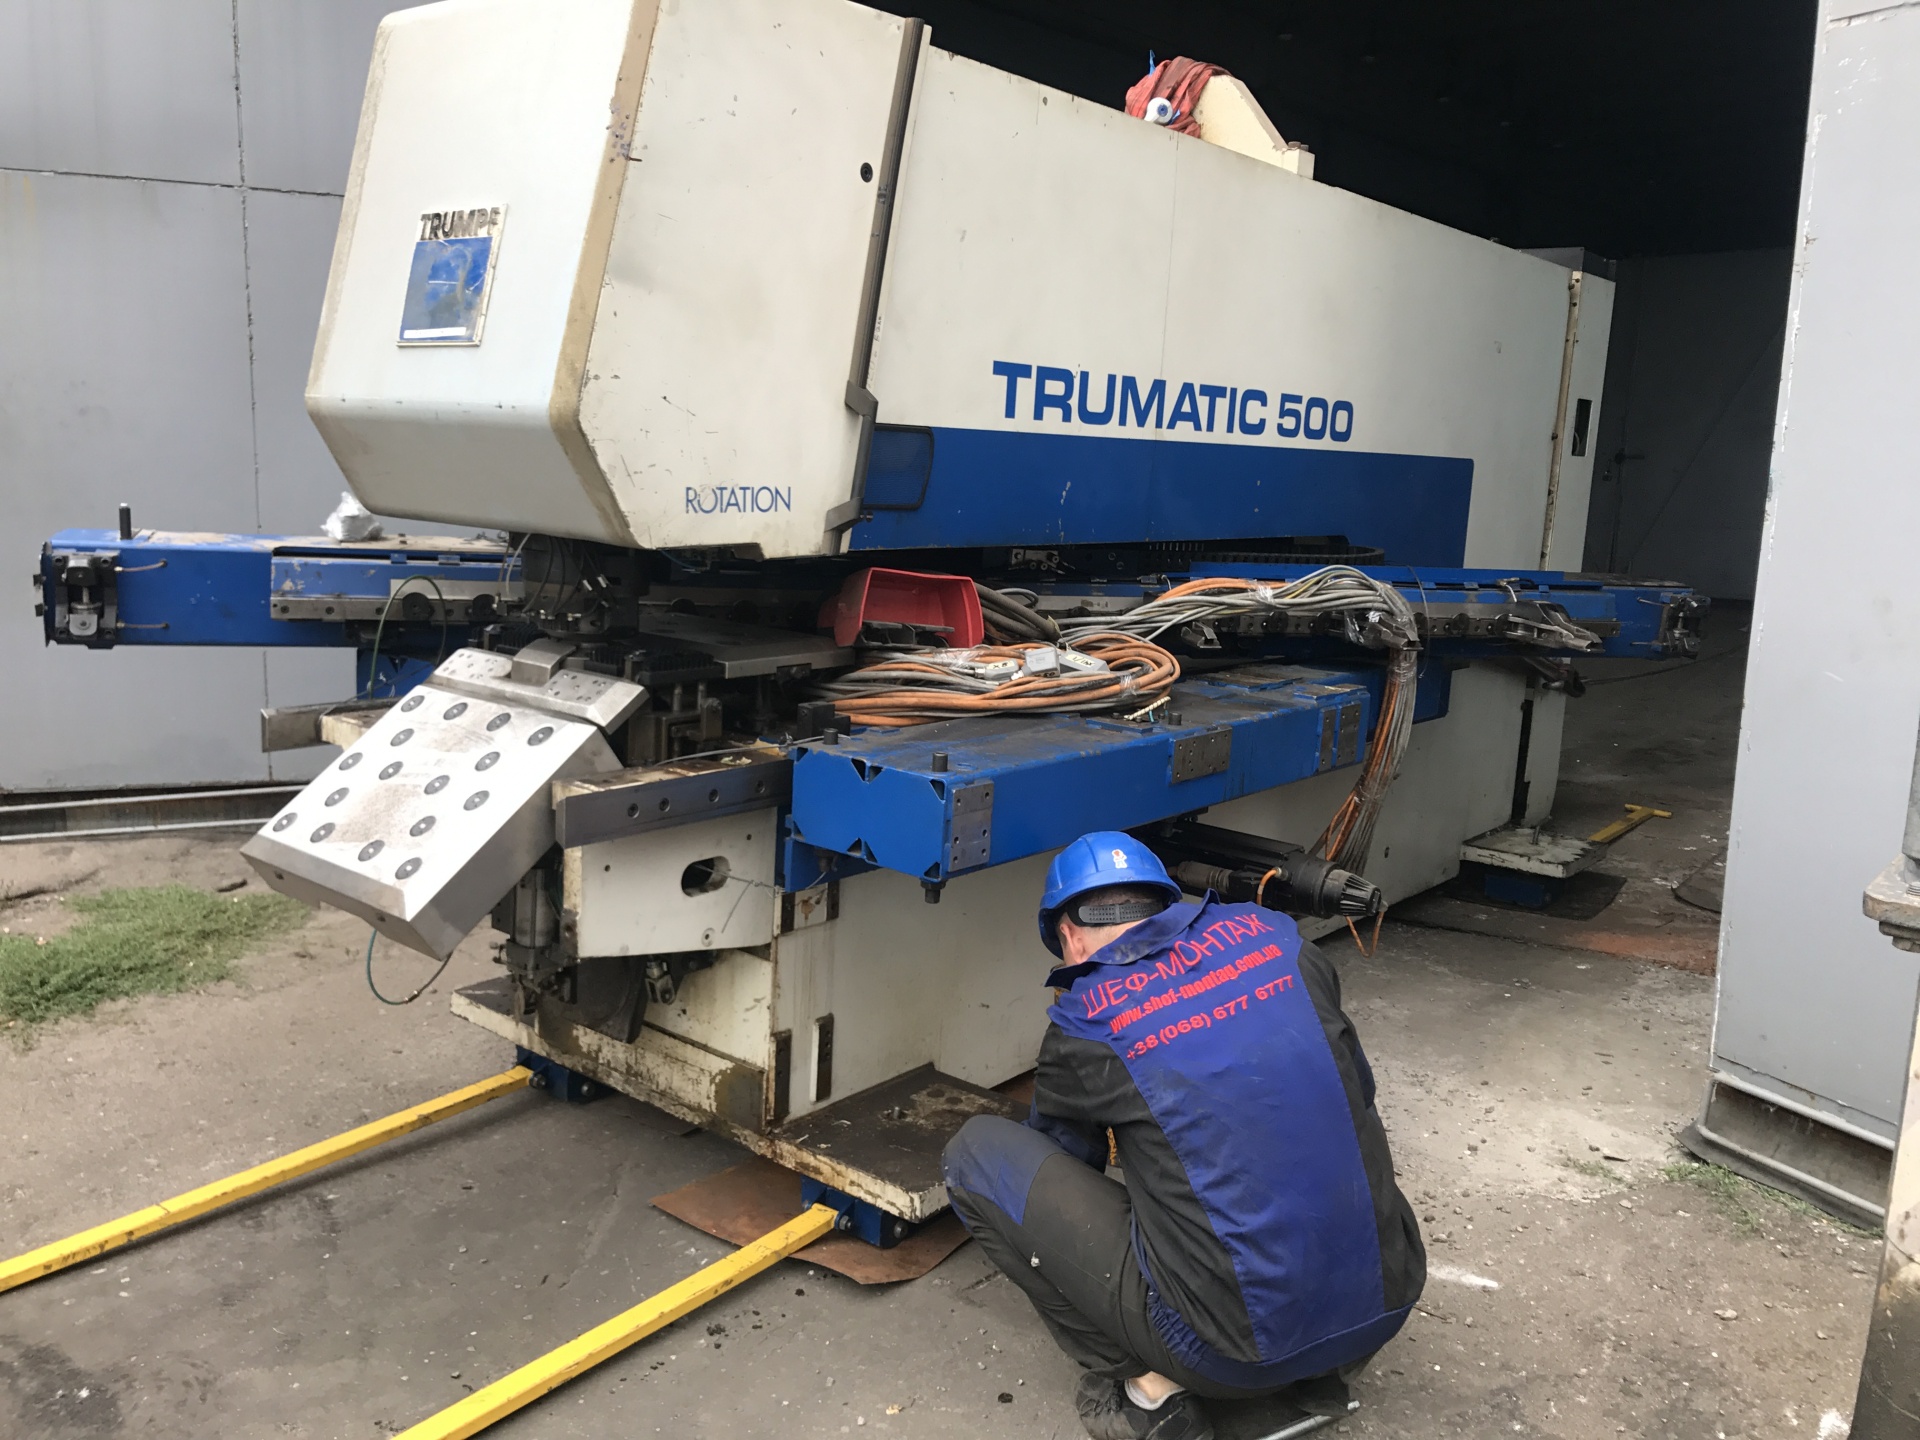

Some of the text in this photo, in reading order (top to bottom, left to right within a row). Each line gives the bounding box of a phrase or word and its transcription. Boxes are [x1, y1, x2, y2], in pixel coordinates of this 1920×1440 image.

[420, 207, 501, 241] TRUMPF
[993, 360, 1354, 442] TRUMATIC 500
[685, 486, 791, 514] ROTATION
[1081, 913, 1275, 1019] ШЕФ-МОНТАЖ
[1212, 994, 1249, 1020] 677
[1254, 974, 1294, 1001] 6777
